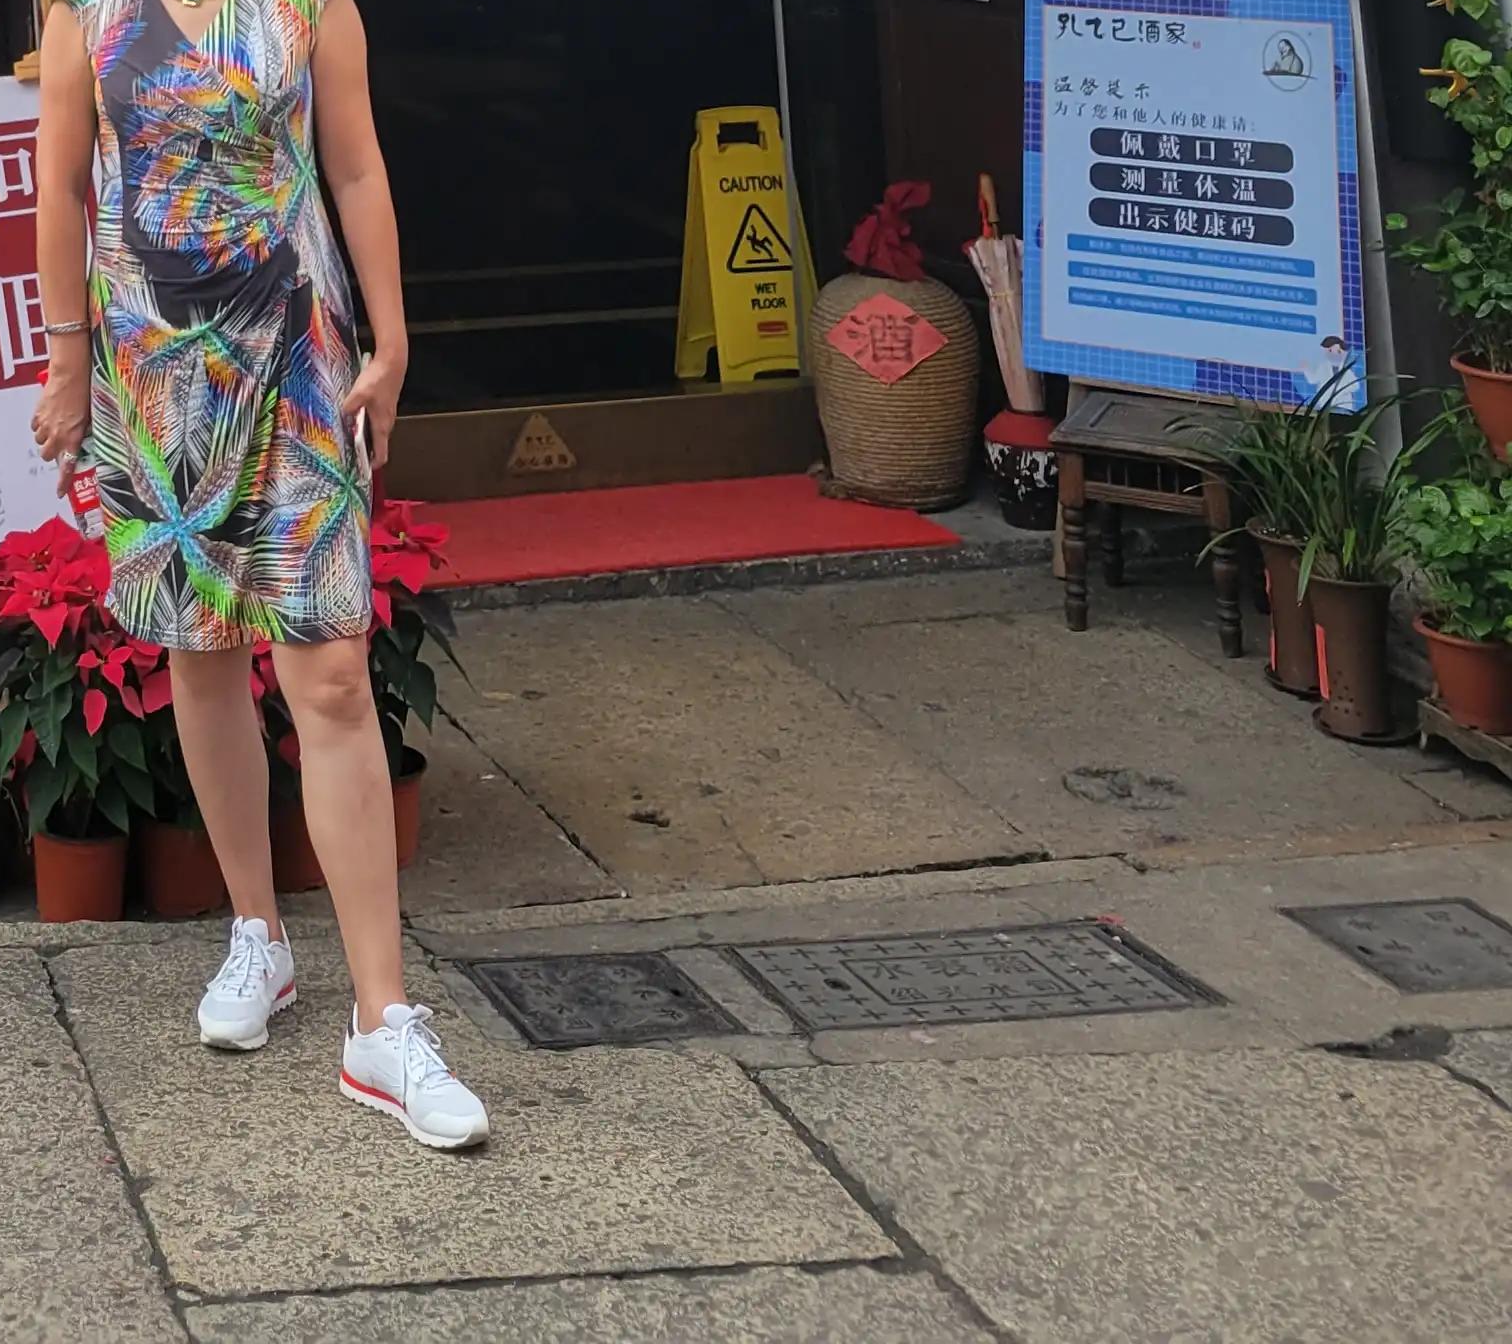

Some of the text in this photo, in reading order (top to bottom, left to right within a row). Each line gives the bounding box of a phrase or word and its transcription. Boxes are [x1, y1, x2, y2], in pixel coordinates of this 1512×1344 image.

[1056, 12, 1188, 45] 孔乙己酒家
[1119, 130, 1256, 167] 佩戴口罩
[719, 174, 784, 193] CAUTION
[1120, 166, 1257, 202] 测量体温
[1118, 202, 1256, 241] 出示健康码
[751, 297, 788, 310] FLOOR
[754, 282, 778, 295] WET
